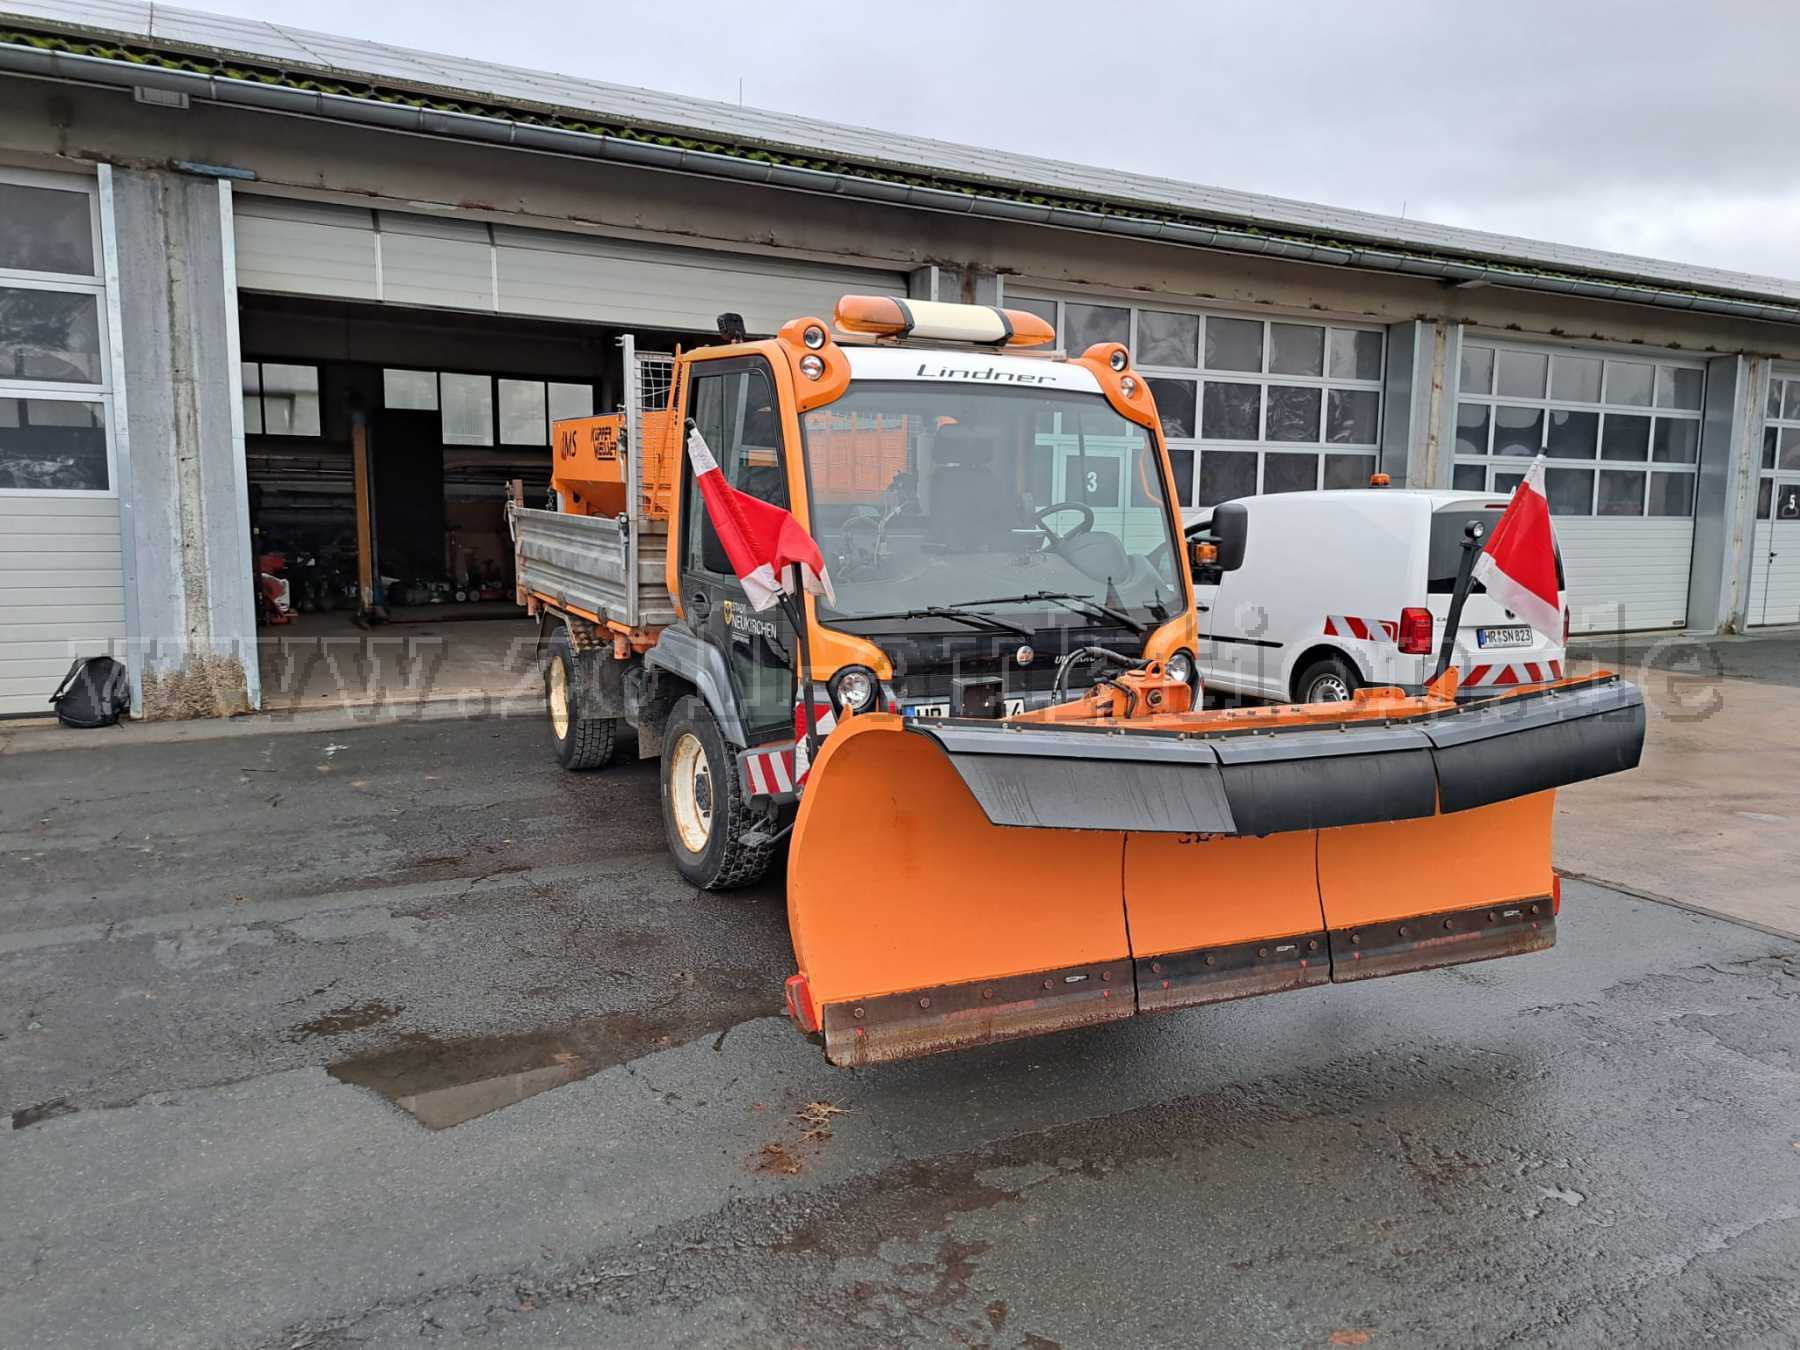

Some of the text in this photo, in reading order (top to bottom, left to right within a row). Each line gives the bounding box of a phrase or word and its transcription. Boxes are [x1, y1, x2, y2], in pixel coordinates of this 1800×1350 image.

[916, 363, 1057, 384] Lindner
[1087, 471, 1098, 492] 3
[1788, 494, 1796, 510] 5
[732, 614, 777, 639] NEUKIRCHEN
[1484, 629, 1530, 643] HR SN 823
